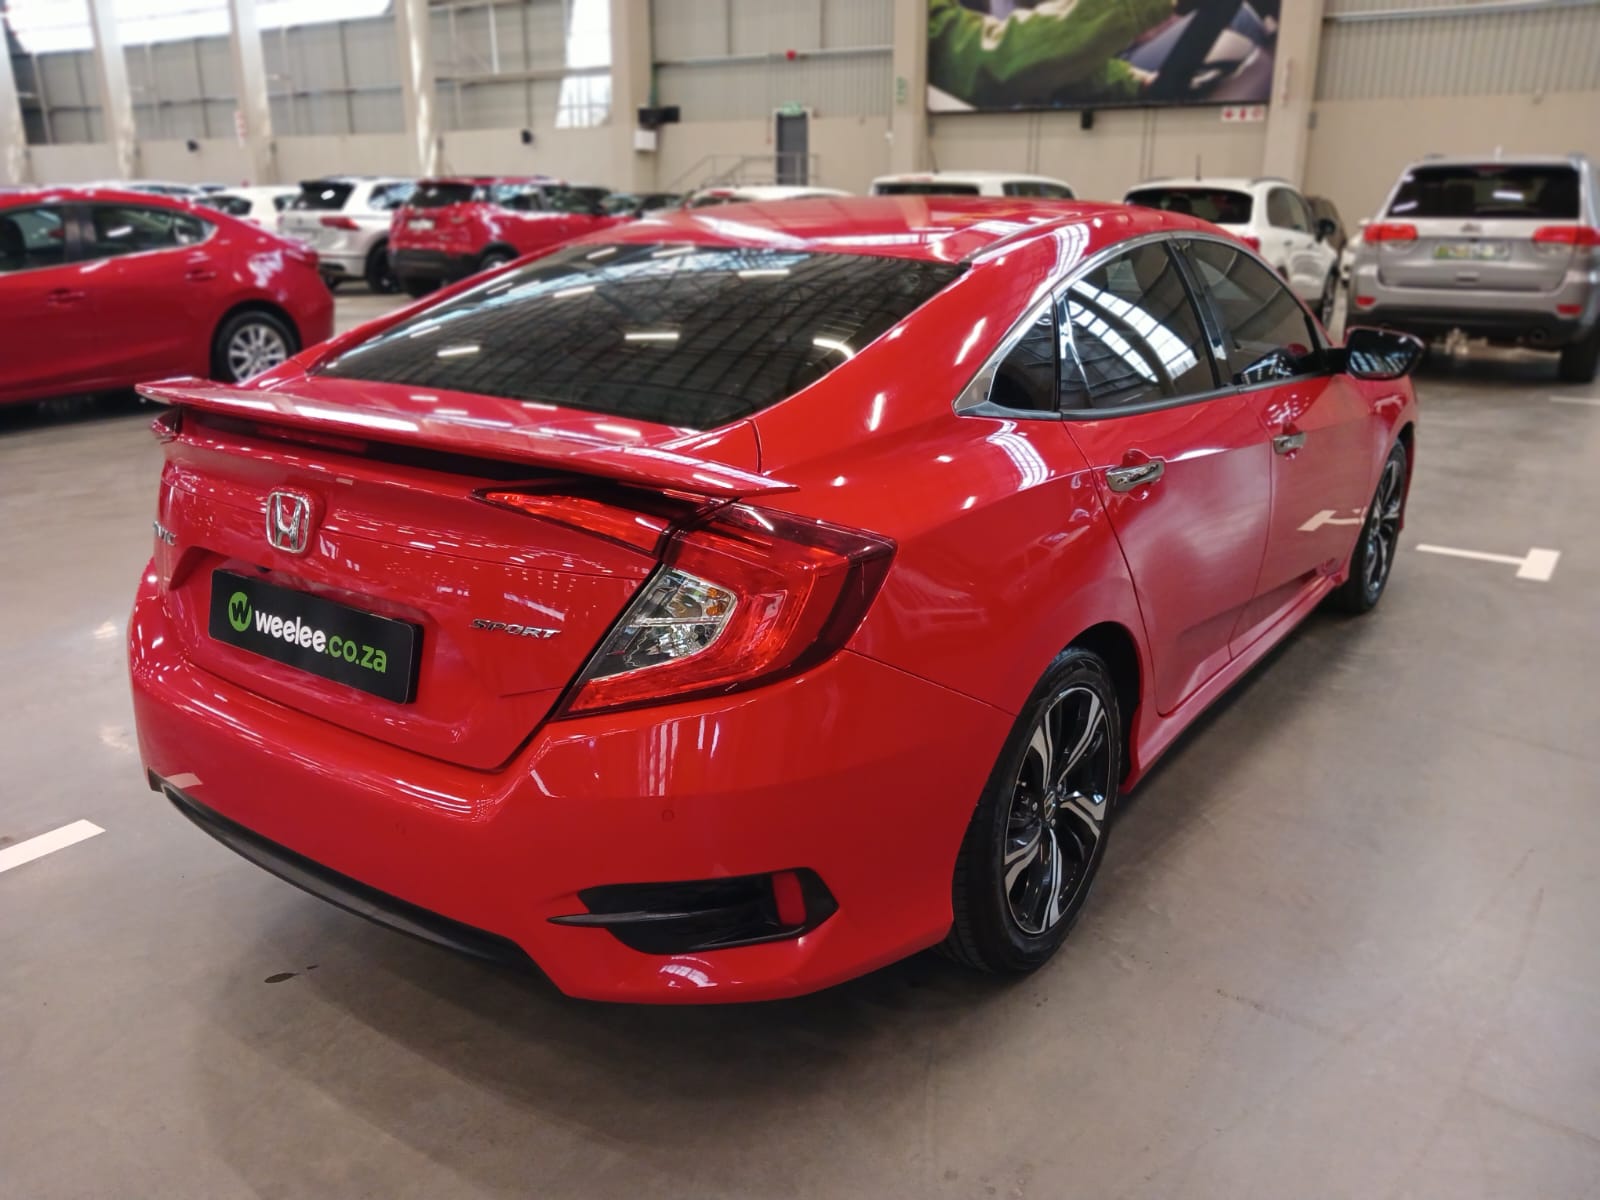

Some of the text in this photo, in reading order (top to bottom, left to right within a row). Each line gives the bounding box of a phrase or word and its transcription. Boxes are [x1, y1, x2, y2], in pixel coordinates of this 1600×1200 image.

[152, 520, 177, 547] VIC
[255, 610, 388, 673] weelee.co.za
[471, 618, 562, 638] SPORT
